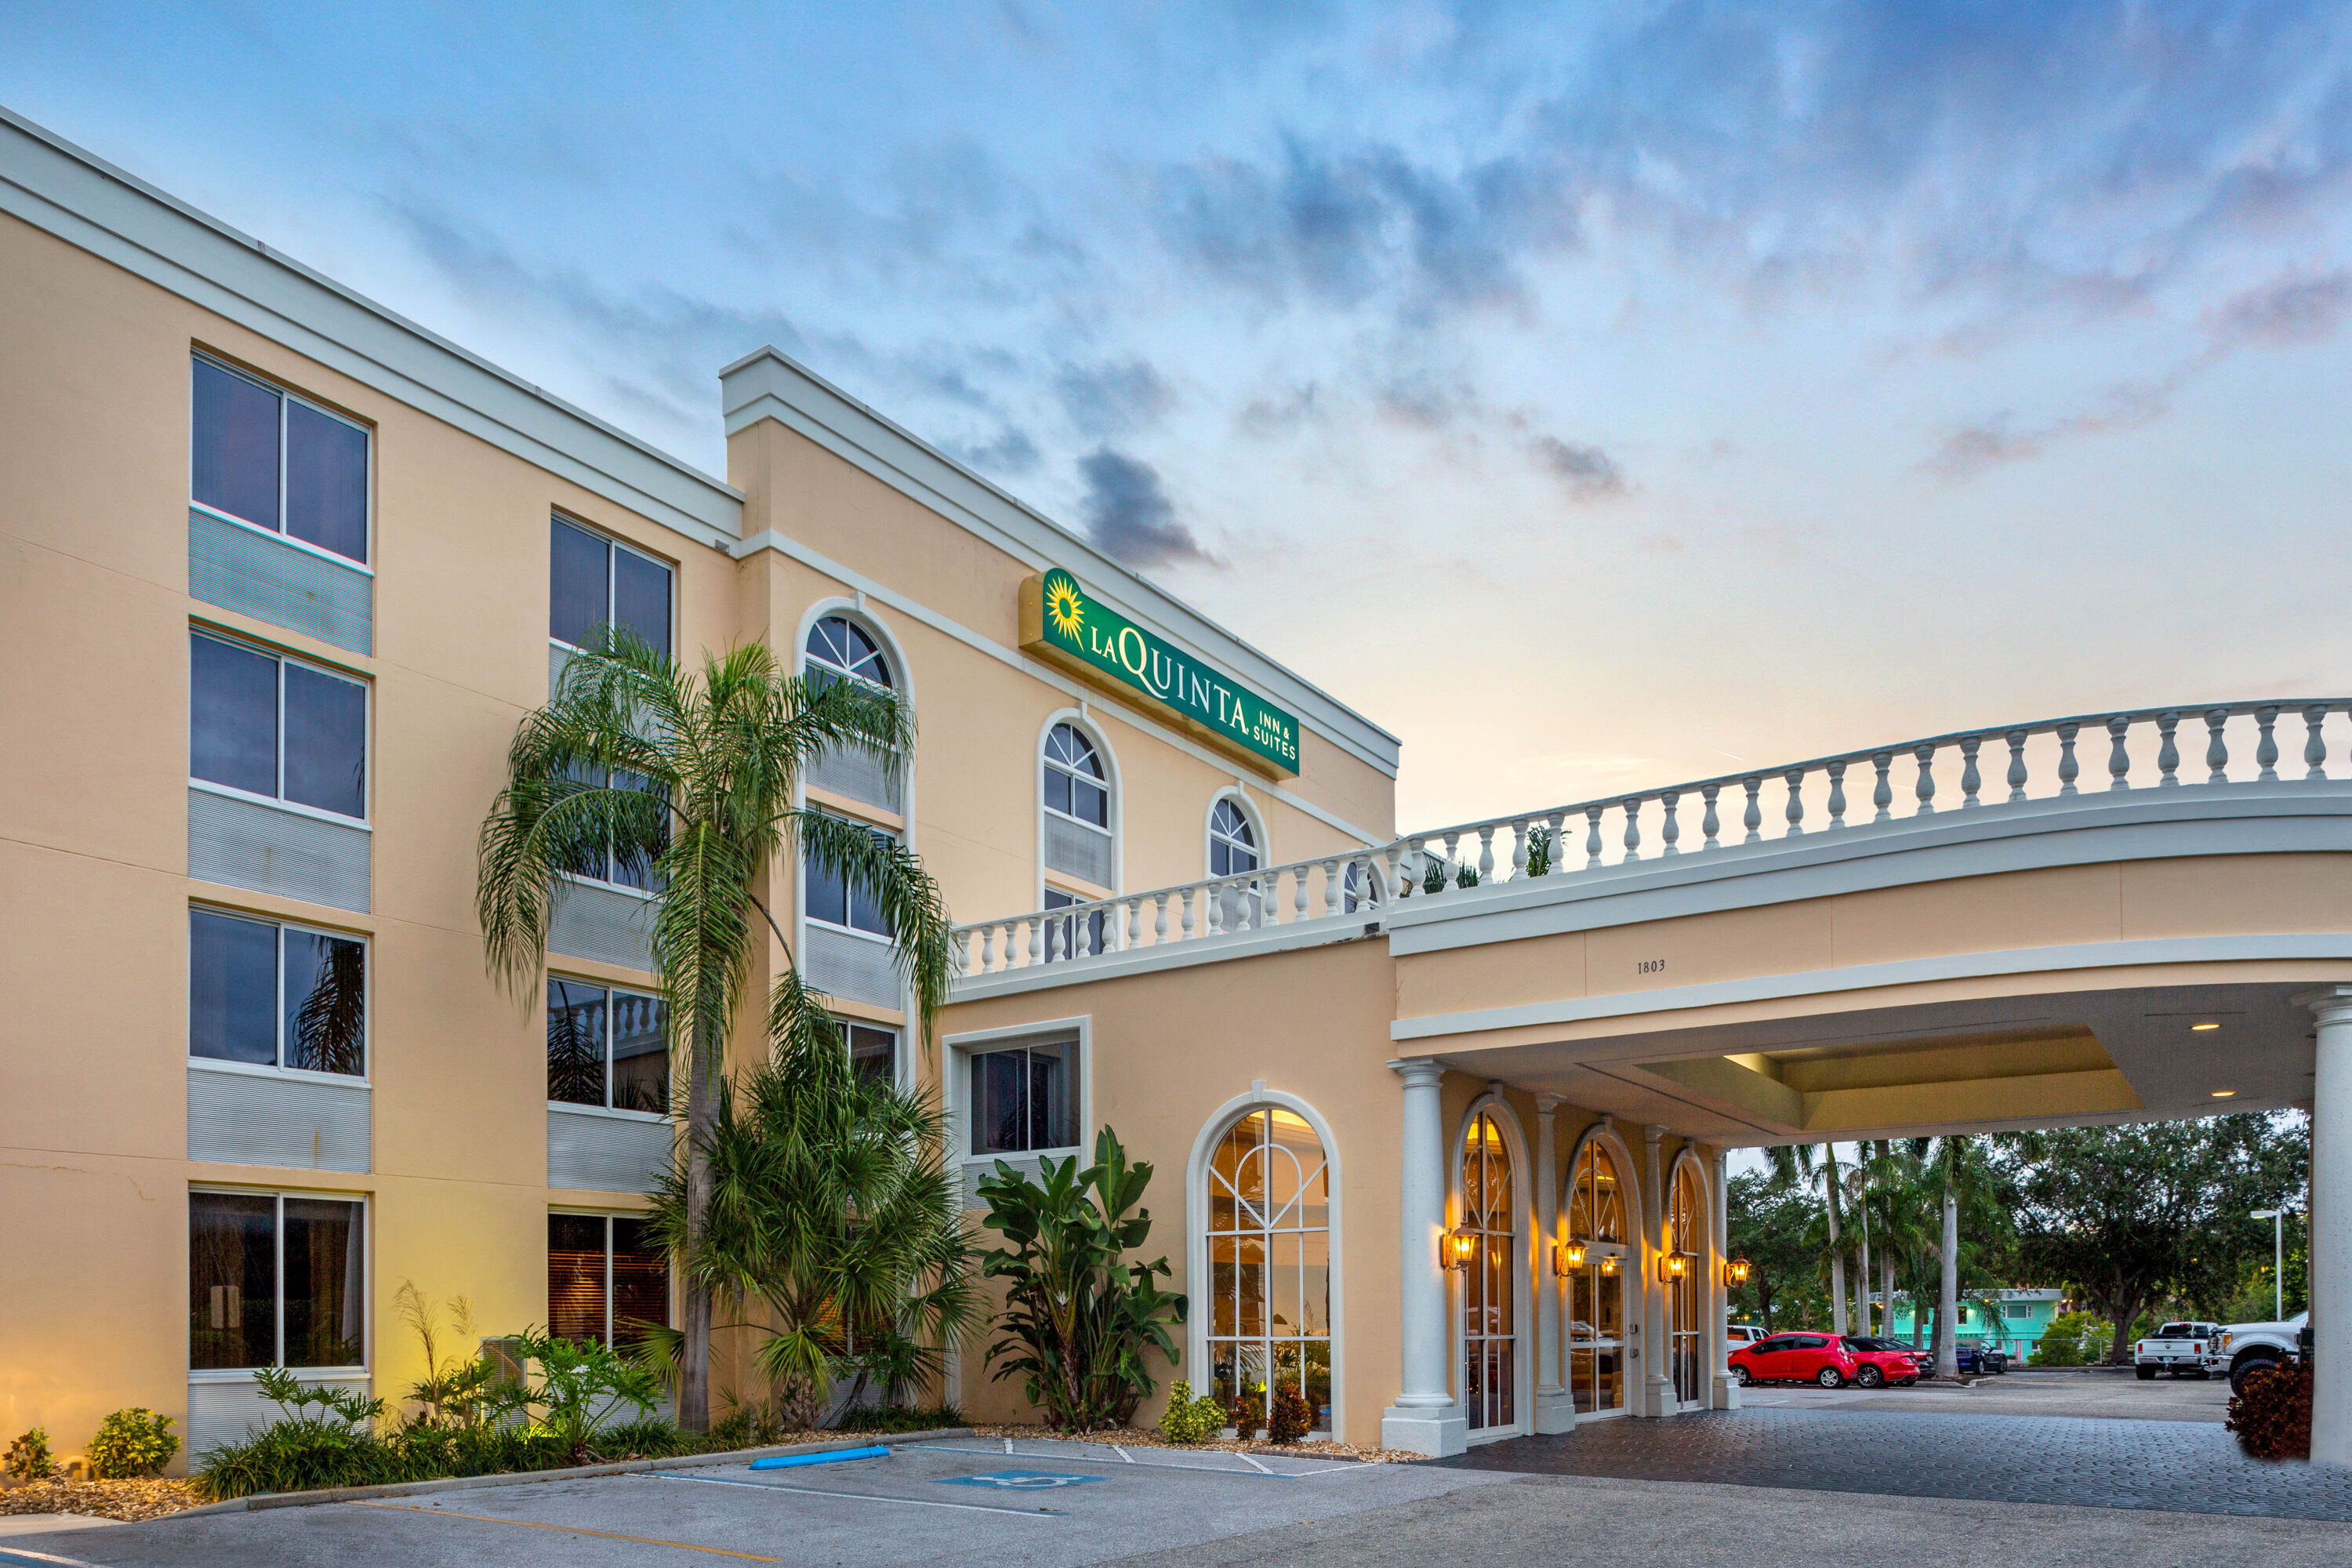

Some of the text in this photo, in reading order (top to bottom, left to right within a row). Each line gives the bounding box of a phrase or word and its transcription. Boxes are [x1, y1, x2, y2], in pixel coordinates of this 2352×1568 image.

[1259, 710, 1290, 740] INN &
[1253, 726, 1296, 760] SUITES
[1638, 959, 1665, 975] 1803
